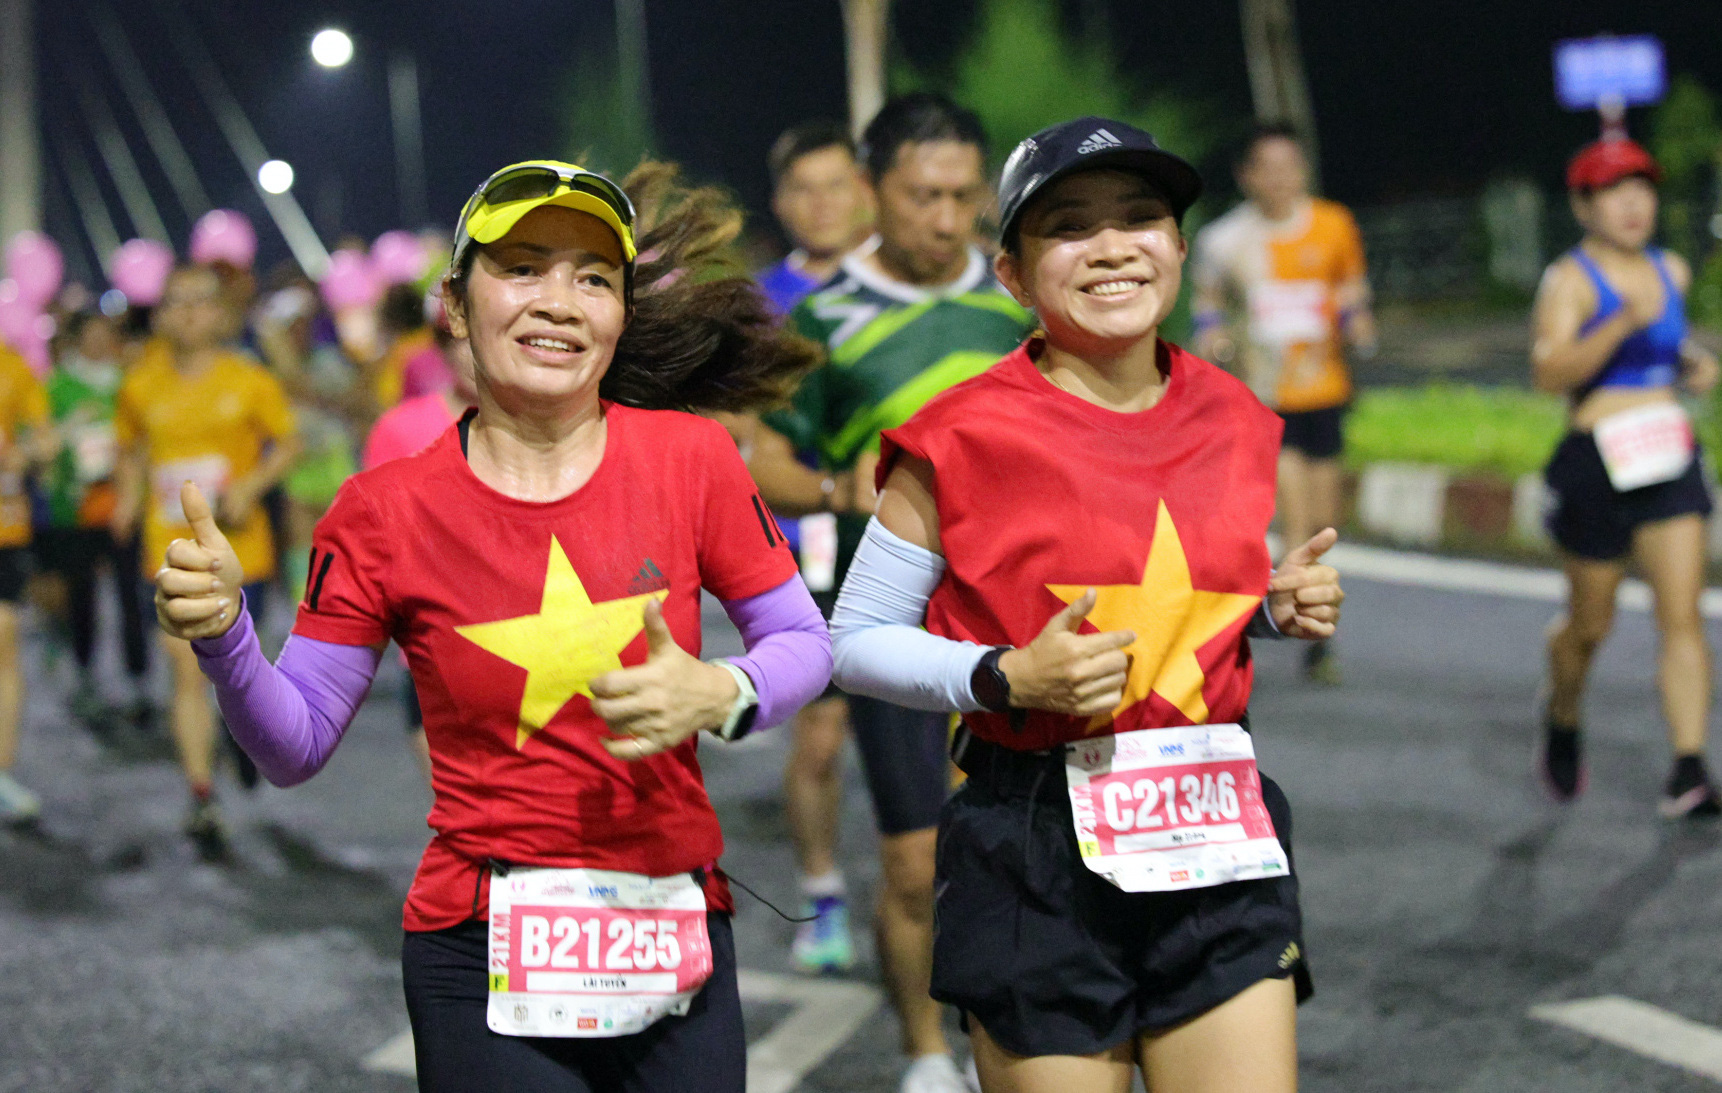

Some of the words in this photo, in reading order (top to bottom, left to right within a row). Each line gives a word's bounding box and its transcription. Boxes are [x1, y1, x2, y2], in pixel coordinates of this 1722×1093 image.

[1103, 771, 1241, 832] C21346
[492, 913, 511, 970] 21KM
[520, 915, 682, 970] B21255
